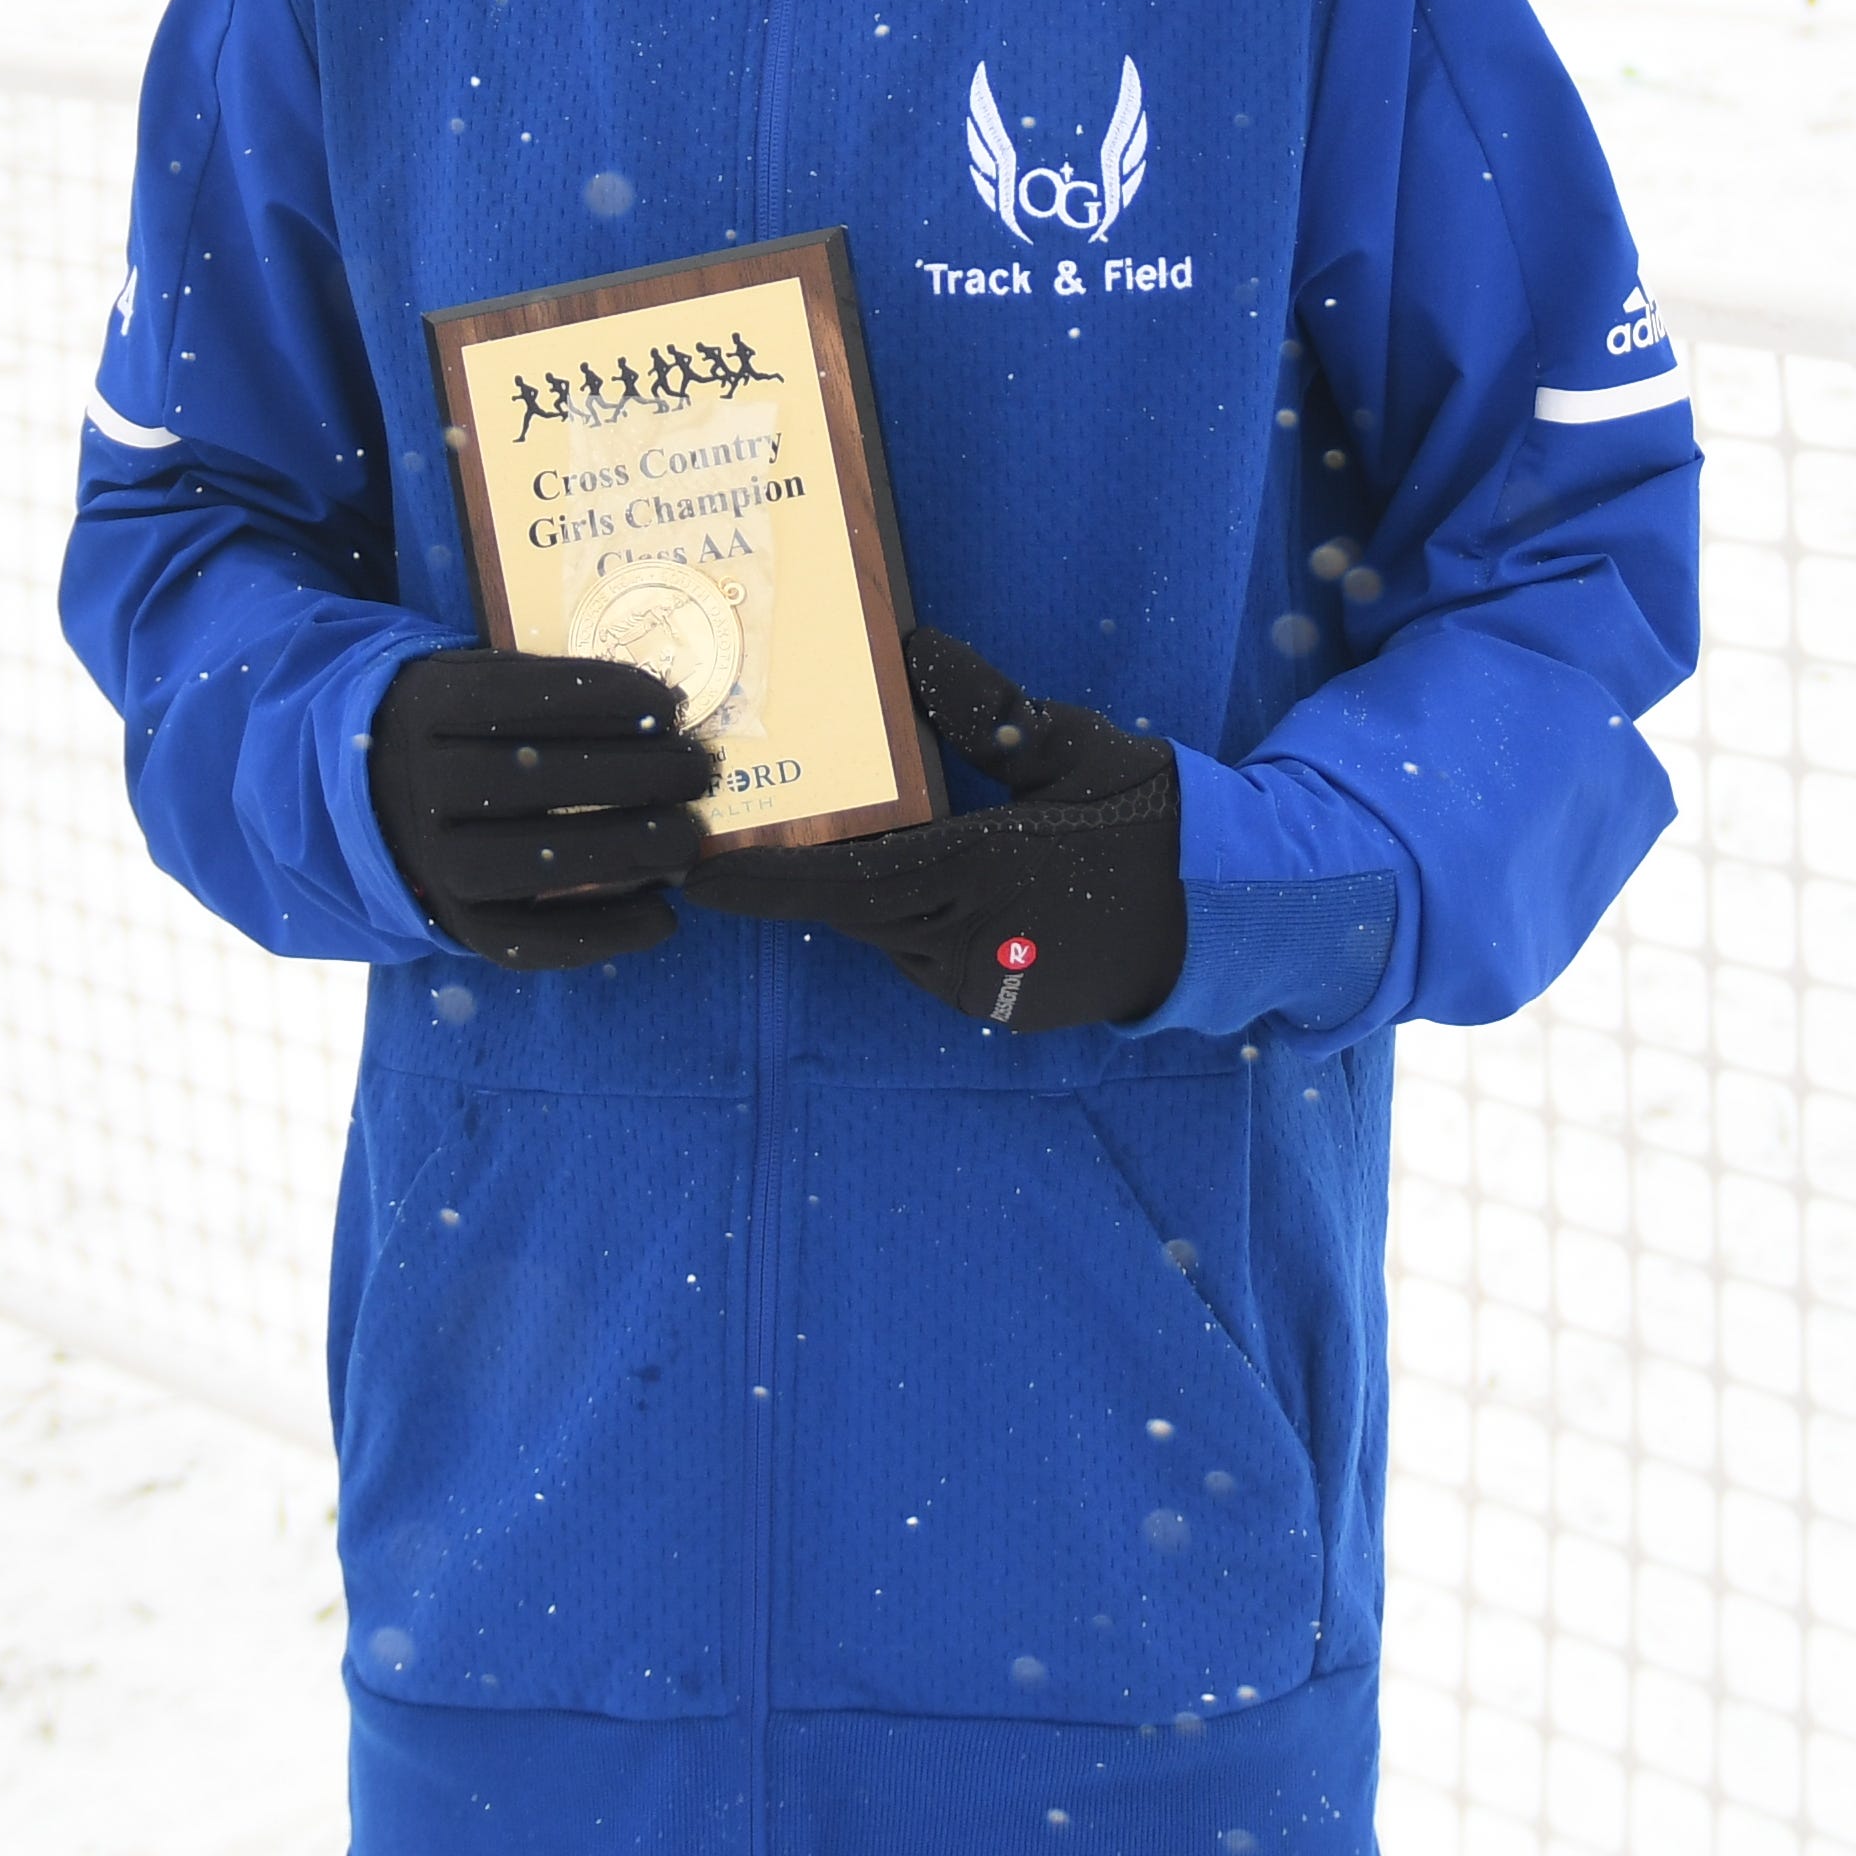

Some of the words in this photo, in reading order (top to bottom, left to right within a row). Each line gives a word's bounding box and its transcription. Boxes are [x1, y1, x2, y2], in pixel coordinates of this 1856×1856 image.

[923, 261, 1033, 295] Track
[1053, 259, 1087, 295] &
[1104, 255, 1194, 292] Field
[532, 463, 631, 501] Cross
[639, 432, 783, 479] Country
[528, 508, 616, 549] Girls
[624, 475, 805, 529] Champion
[596, 545, 689, 577] Cls
[698, 528, 754, 564] AA
[710, 797, 774, 819] ALTH
